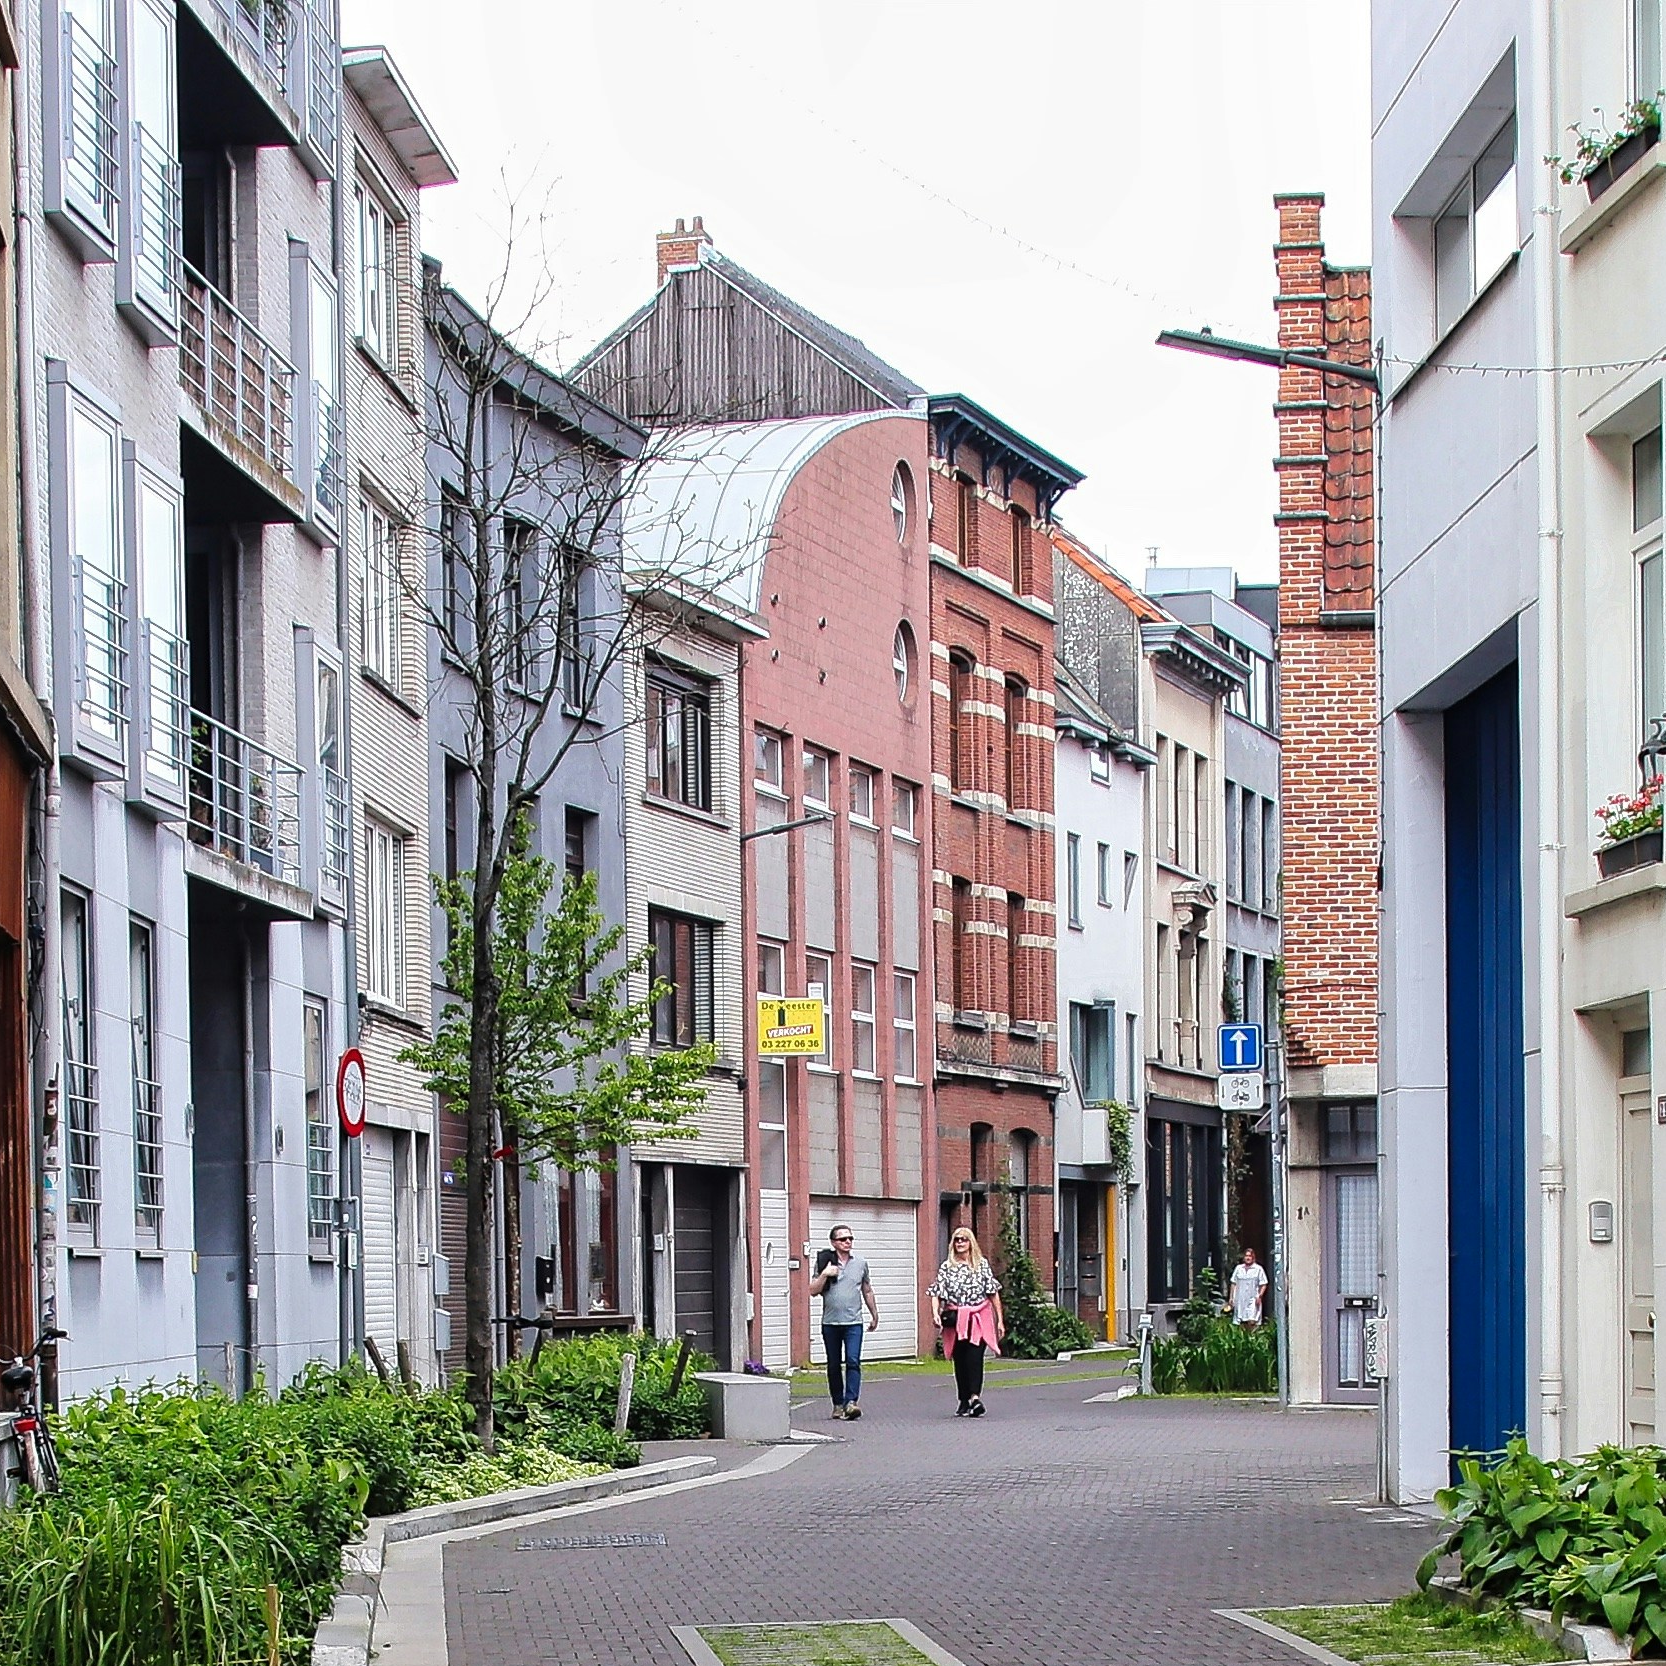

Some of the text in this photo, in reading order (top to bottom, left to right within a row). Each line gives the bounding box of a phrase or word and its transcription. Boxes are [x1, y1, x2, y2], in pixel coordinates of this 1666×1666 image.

[761, 1001, 774, 1010] De
[767, 1026, 813, 1038] VERKOCHT
[761, 1040, 774, 1048] 03
[775, 1040, 792, 1048] 227
[794, 1039, 806, 1048] 06
